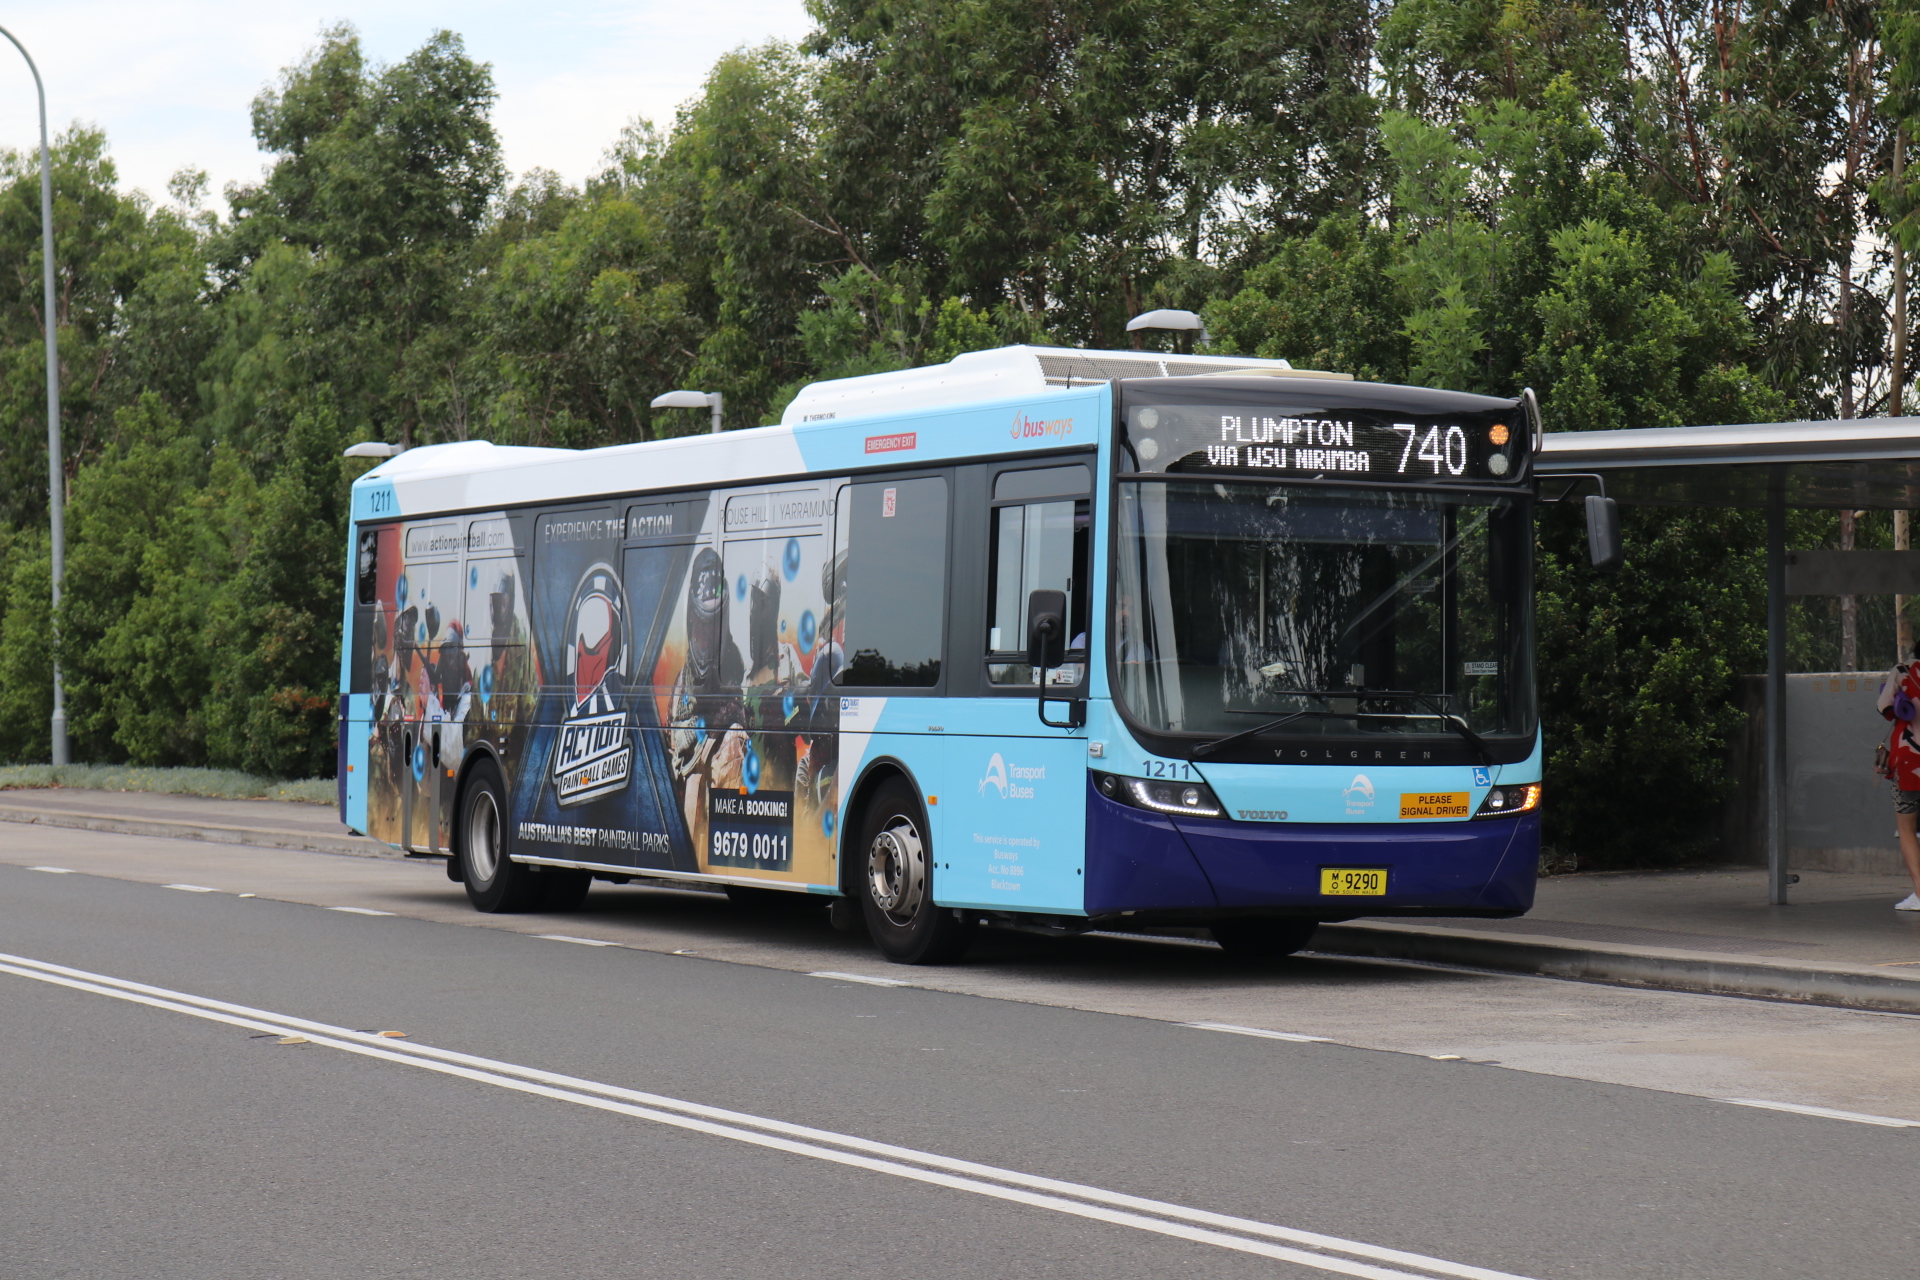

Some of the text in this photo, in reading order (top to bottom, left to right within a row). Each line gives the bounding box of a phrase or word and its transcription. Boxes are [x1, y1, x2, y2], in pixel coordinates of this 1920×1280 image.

[1023, 416, 1074, 440] busways
[1221, 416, 1353, 446] PLUMPTON
[867, 436, 914, 450] EMERGENCY EXIT
[1393, 424, 1467, 476] 740
[1207, 445, 1370, 472] VIA WSU NIRIMBA
[370, 490, 391, 513] 1211
[720, 507, 748, 526] ROUSE
[752, 506, 768, 522] HILL
[545, 514, 673, 544] EXPERIENCE THE ACTION
[560, 718, 622, 767] ACTION
[1274, 750, 1430, 759] VOLGREN
[602, 752, 627, 780] GAMES
[1008, 763, 1046, 782] Transport
[1142, 760, 1190, 780] 1211
[1010, 783, 1034, 799] Buses
[1418, 795, 1452, 804] PLEASE
[715, 798, 788, 817] MAKE A BOOKING!
[1238, 810, 1288, 820] VOLVO
[1401, 806, 1468, 816] SIGNAL DRIVER
[518, 822, 670, 854] AUSTRALIA'S BEST PAINTBALL PARKS
[714, 831, 787, 860] 9679 0011
[973, 833, 984, 844] This
[984, 835, 1002, 845] service
[1008, 836, 1032, 847] operated
[1033, 838, 1040, 849] by
[994, 849, 1018, 862] Busways
[1000, 865, 1009, 875] No
[991, 879, 1020, 891] Blacktown
[1345, 873, 1378, 890] 9290
